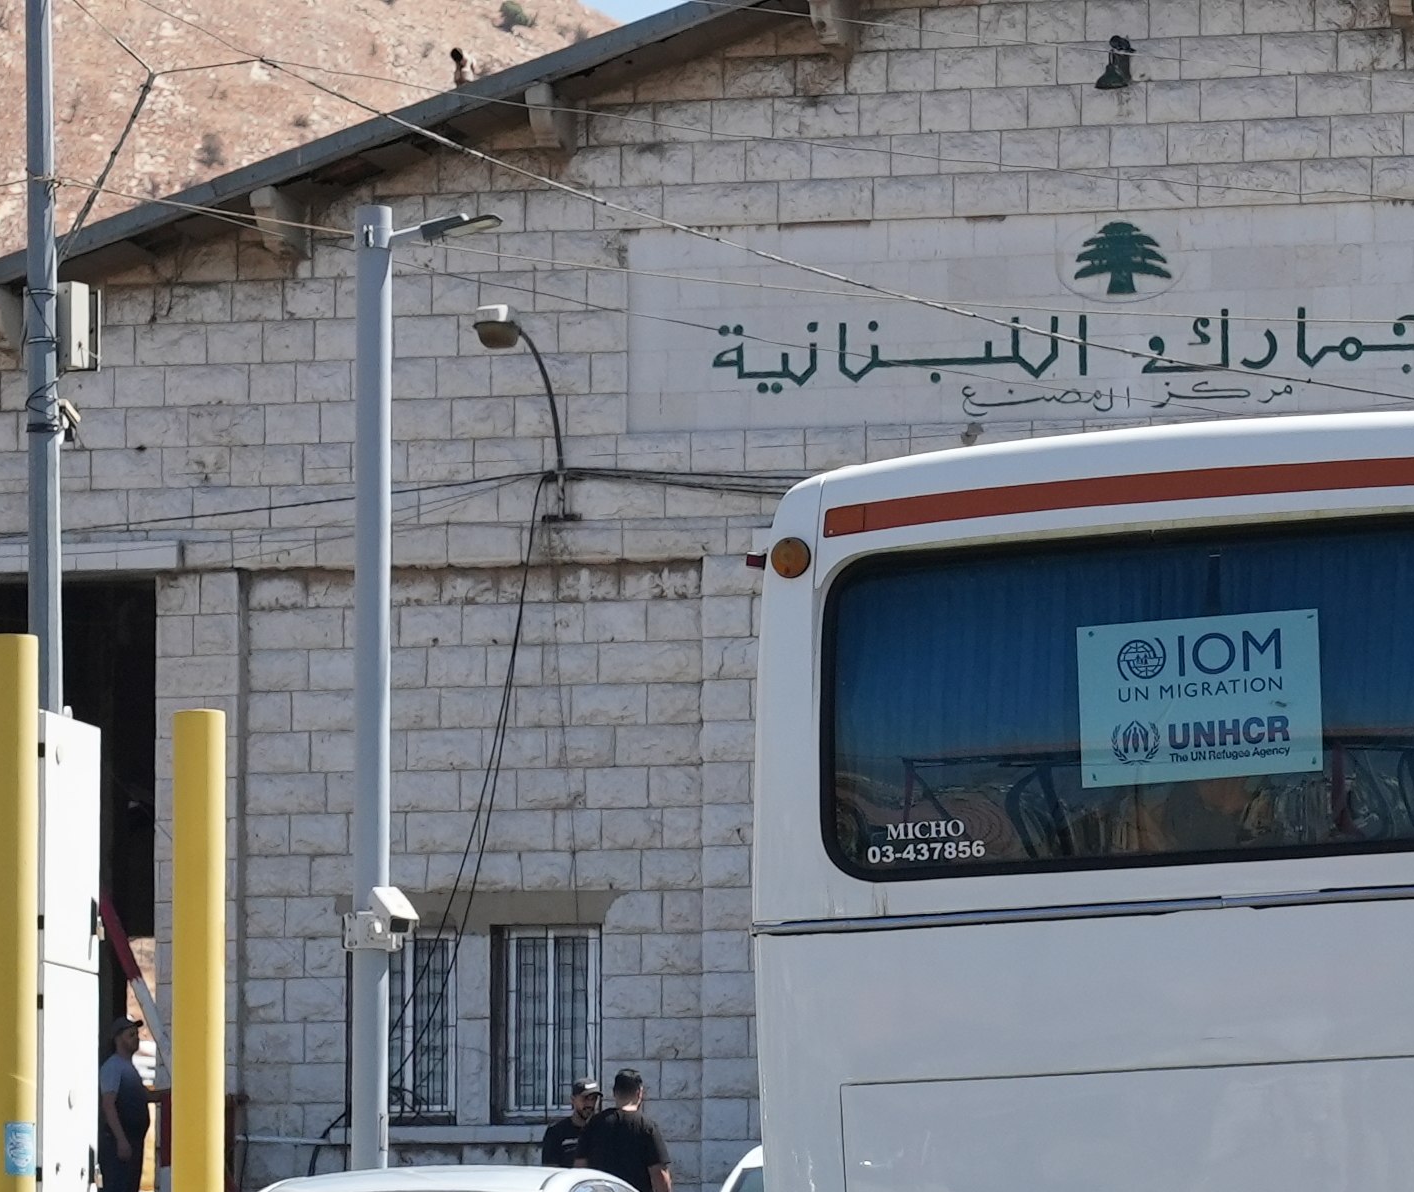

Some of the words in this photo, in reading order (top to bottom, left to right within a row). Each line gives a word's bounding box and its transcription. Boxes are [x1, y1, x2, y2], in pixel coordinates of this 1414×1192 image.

[712, 314, 1087, 394] اللبنانية
[1150, 381, 1293, 408] مركز
[1177, 627, 1283, 677] IOM
[1117, 686, 1149, 703] UN
[1159, 675, 1284, 700] MIGRATION
[1168, 715, 1291, 750] UNHCR
[1169, 752, 1188, 763] The
[1190, 751, 1207, 762] UN
[1209, 749, 1251, 761] Refugee
[1252, 746, 1291, 759] Agency
[885, 819, 965, 841] MICHO
[867, 840, 986, 864] 03-437856
